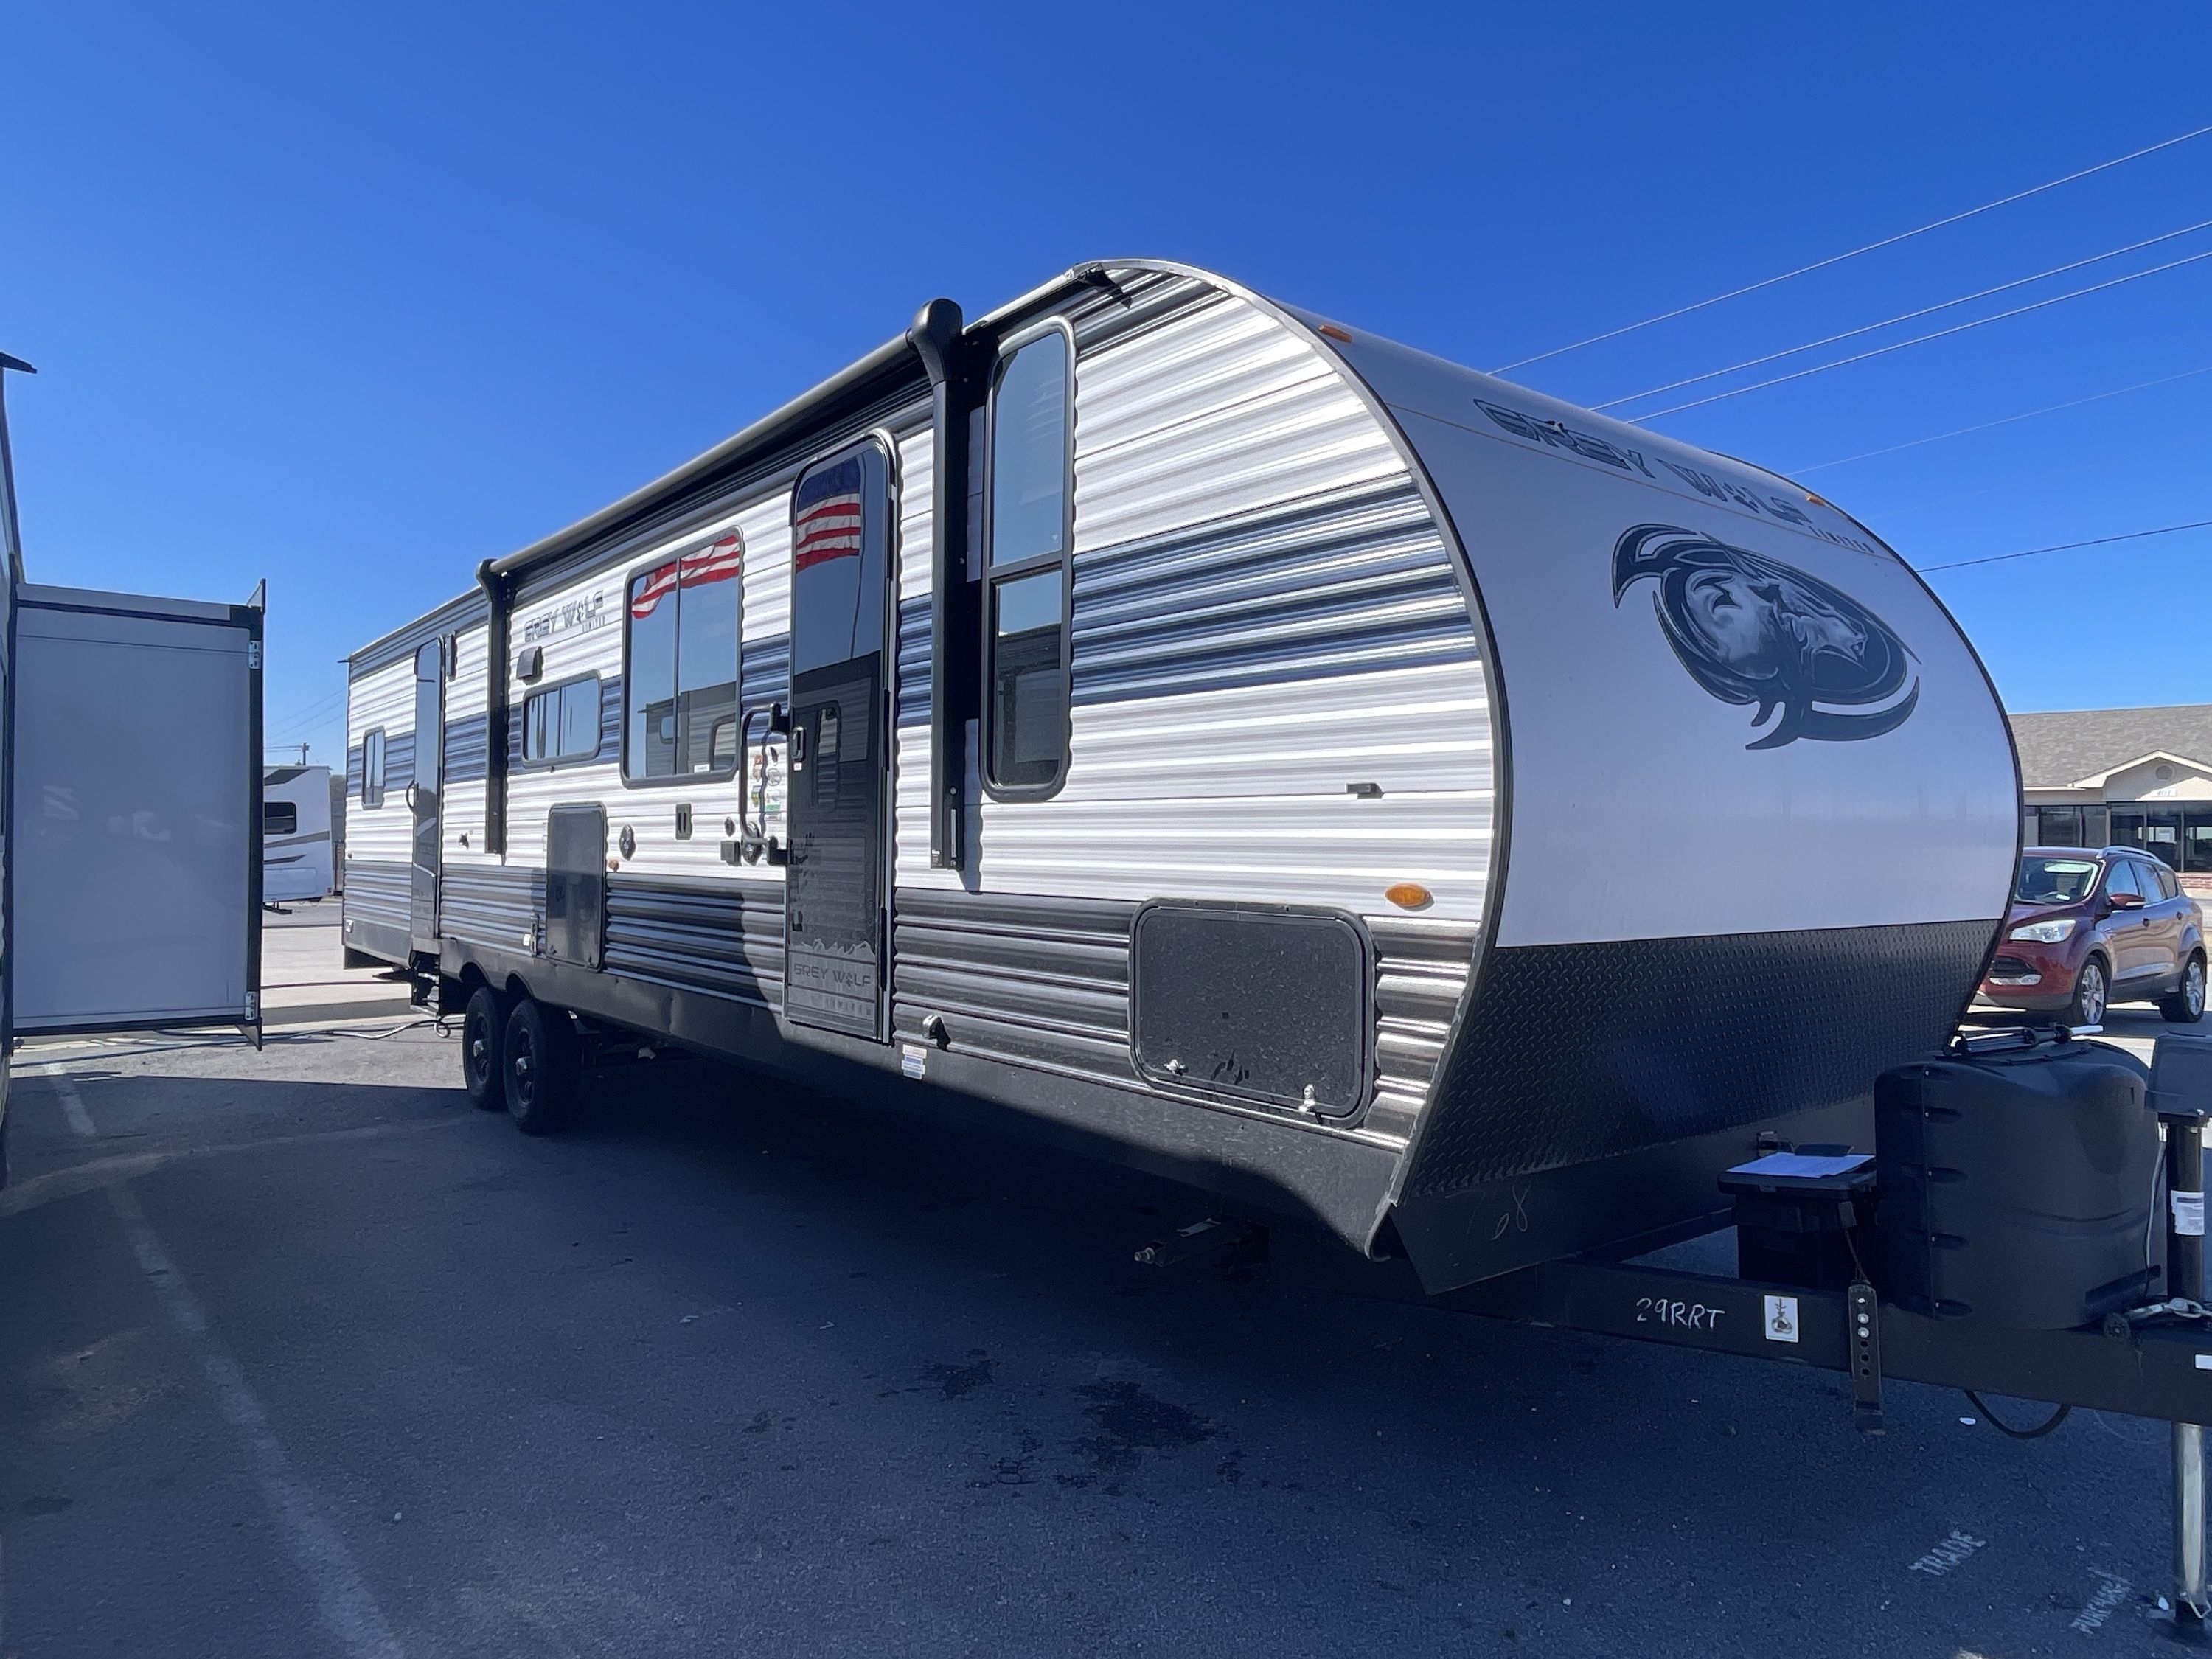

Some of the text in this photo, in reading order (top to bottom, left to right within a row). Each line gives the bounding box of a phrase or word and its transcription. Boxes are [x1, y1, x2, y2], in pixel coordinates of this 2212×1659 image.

[1472, 398, 1813, 526] GREY WOLF
[524, 608, 559, 642] GREY
[562, 589, 604, 628] WOLF
[794, 963, 871, 987] GREY WOLF
[1635, 1298, 1726, 1329] 29RRT
[1907, 1528, 1986, 1576] TRADE
